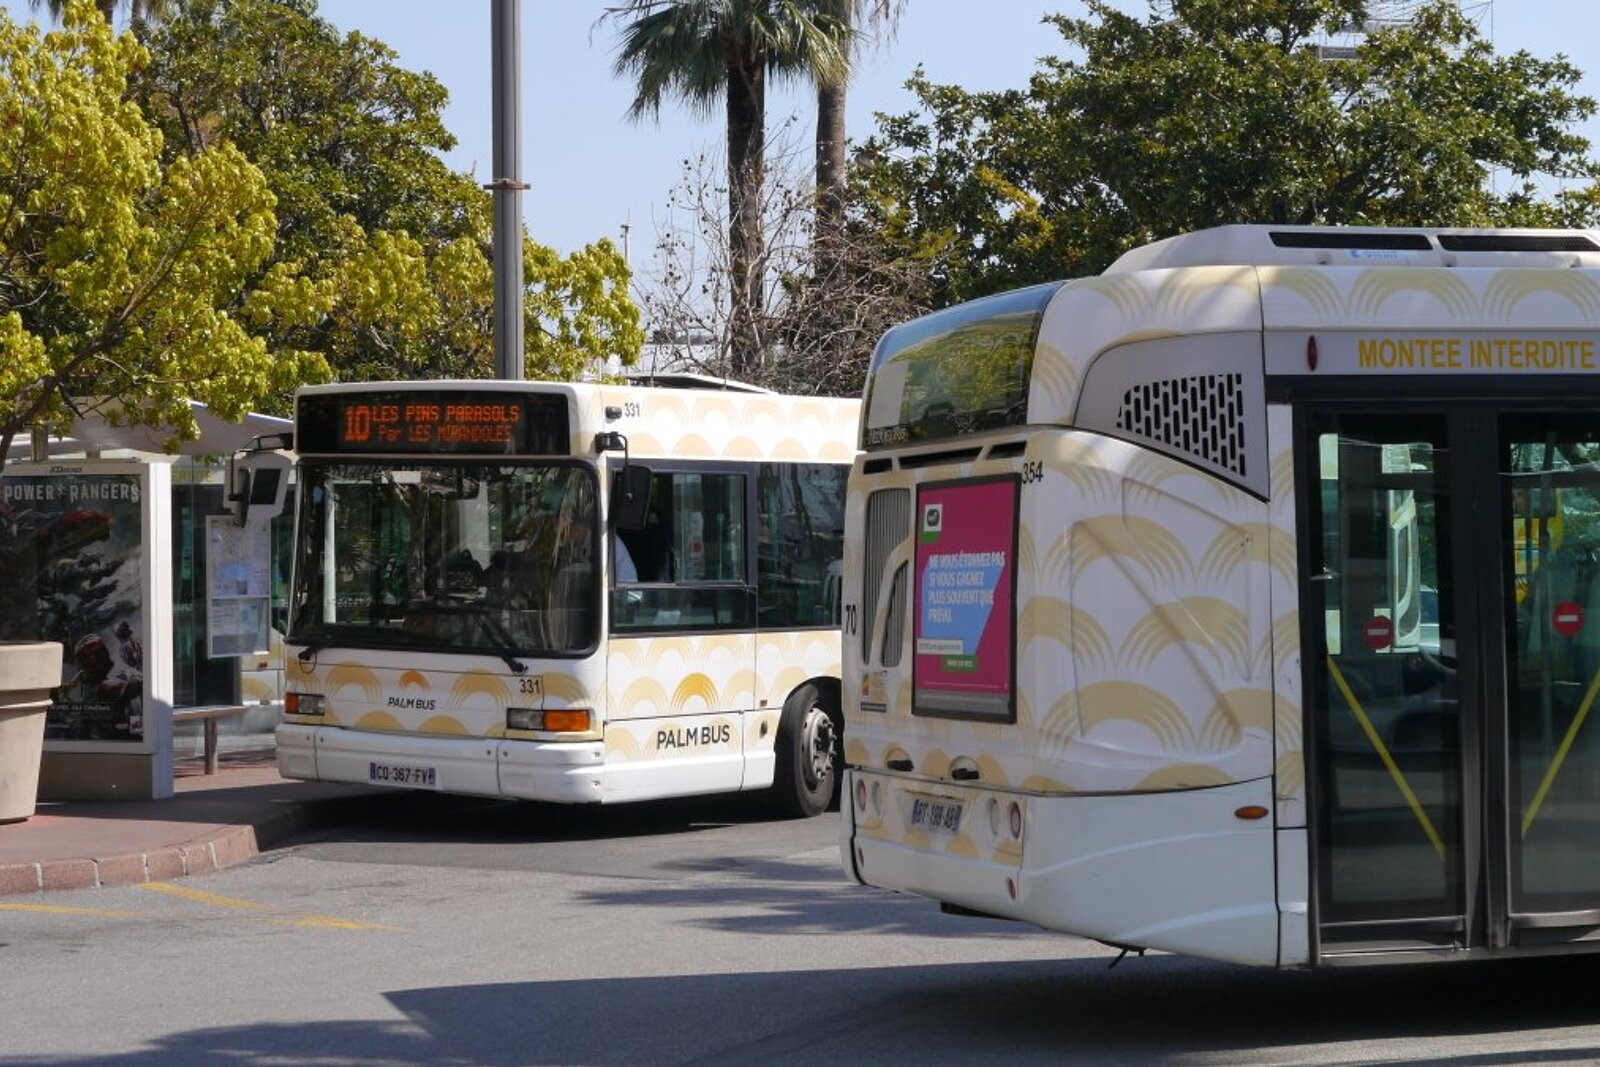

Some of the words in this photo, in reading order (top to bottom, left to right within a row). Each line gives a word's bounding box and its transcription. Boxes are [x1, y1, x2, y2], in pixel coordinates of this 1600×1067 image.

[1358, 339, 1462, 368] MONTEE
[1470, 340, 1596, 369] INTERDITE
[372, 405, 399, 422] LES
[406, 405, 440, 422] PINS
[446, 405, 520, 422] PARASOLS
[624, 402, 640, 418] 331
[344, 405, 370, 441] 10
[408, 425, 431, 442] LES
[1022, 462, 1044, 484] 354
[4, 484, 54, 502] POWER
[69, 482, 139, 503] RANGERS
[845, 604, 857, 635] 70
[519, 679, 540, 694] 331
[387, 697, 414, 709] PALM
[416, 699, 436, 710] BUS
[657, 727, 697, 749] PALM
[701, 724, 730, 745] BUS
